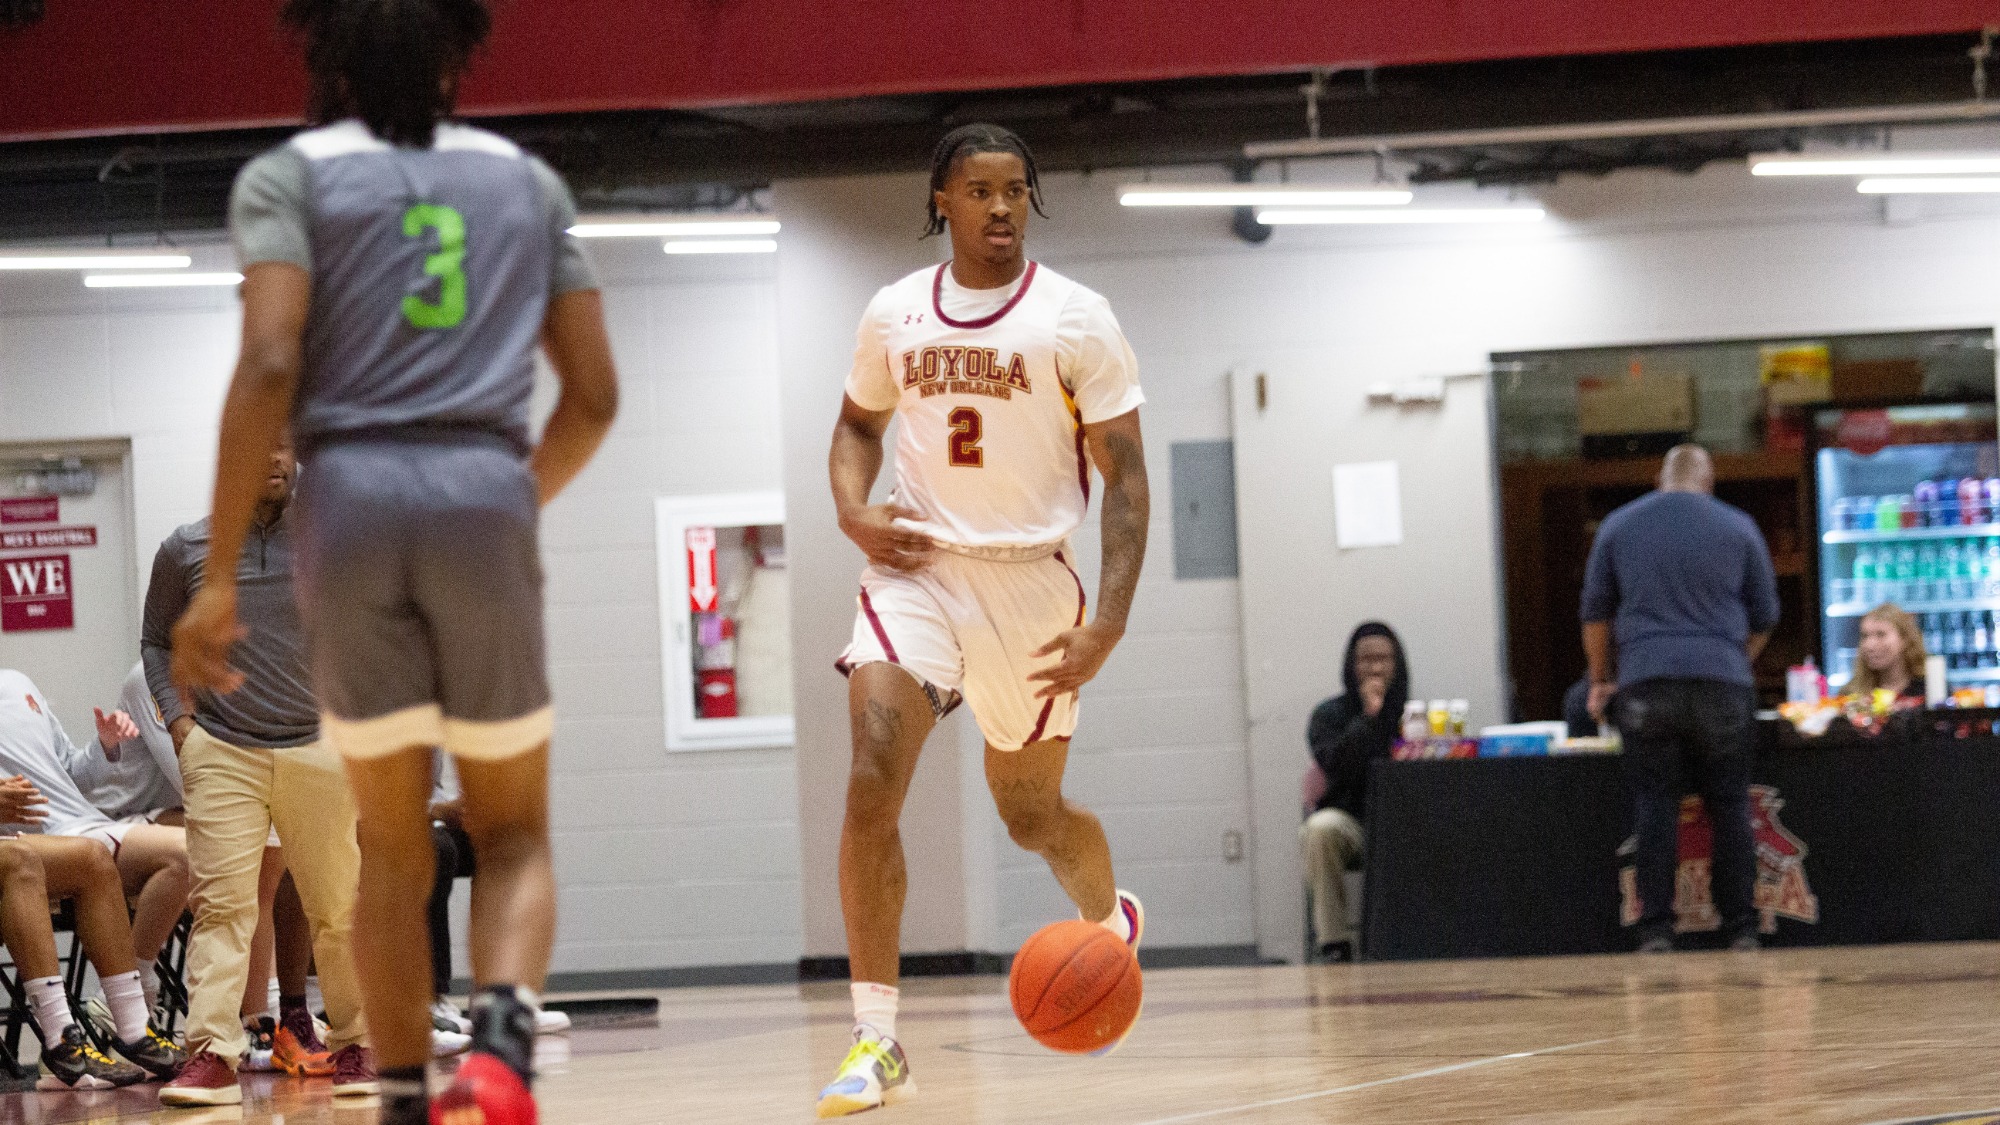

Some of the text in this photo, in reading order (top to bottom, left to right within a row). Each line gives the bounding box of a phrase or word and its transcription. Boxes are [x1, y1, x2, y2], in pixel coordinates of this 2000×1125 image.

[402, 204, 466, 328] 3
[903, 345, 1031, 394] LOYOLA
[919, 380, 1012, 400] NEW ORLEANS
[948, 406, 983, 468] 2
[6, 560, 66, 596] WE
